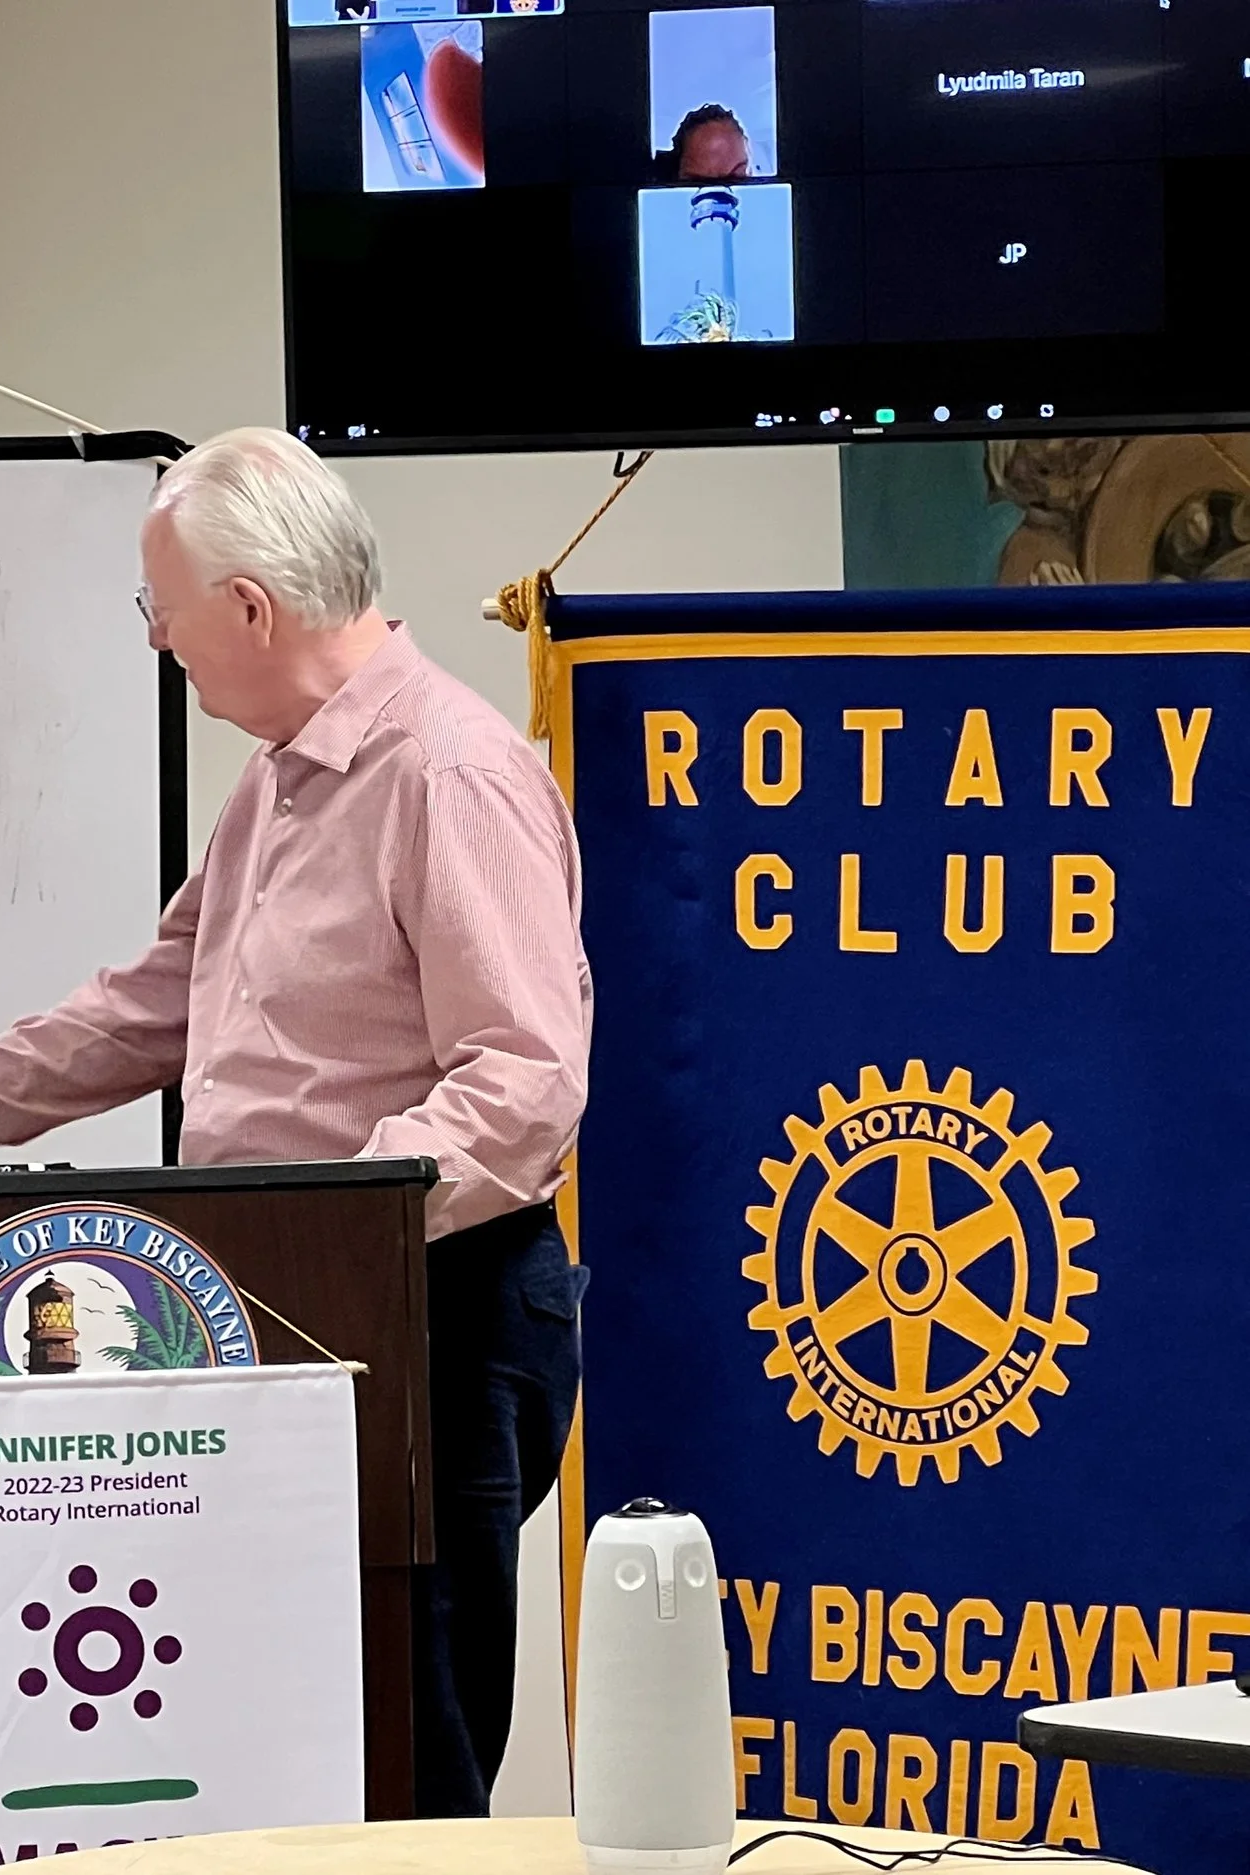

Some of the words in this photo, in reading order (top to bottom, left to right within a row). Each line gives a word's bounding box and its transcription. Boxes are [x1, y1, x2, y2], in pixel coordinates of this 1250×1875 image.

[938, 71, 1027, 96] Lyudmila
[1030, 69, 1086, 88] Taran
[999, 243, 1027, 264] JP
[643, 708, 1212, 807] ROTARY
[734, 853, 1116, 954] CLUB
[840, 1106, 989, 1155] ROTARY
[12, 1222, 56, 1259] OF
[67, 1216, 137, 1249] KEY
[140, 1230, 248, 1363] BISCAYNE
[793, 1335, 1036, 1441] INTERNATIONAL
[3, 1476, 84, 1496] 2022-23
[90, 1471, 188, 1492] President
[122, 1428, 227, 1466] JONES
[66, 1496, 201, 1520] International
[718, 1579, 780, 1674] Y
[811, 1585, 1250, 1700] BISCAYNE
[731, 1717, 1100, 1849] FLORIDA
